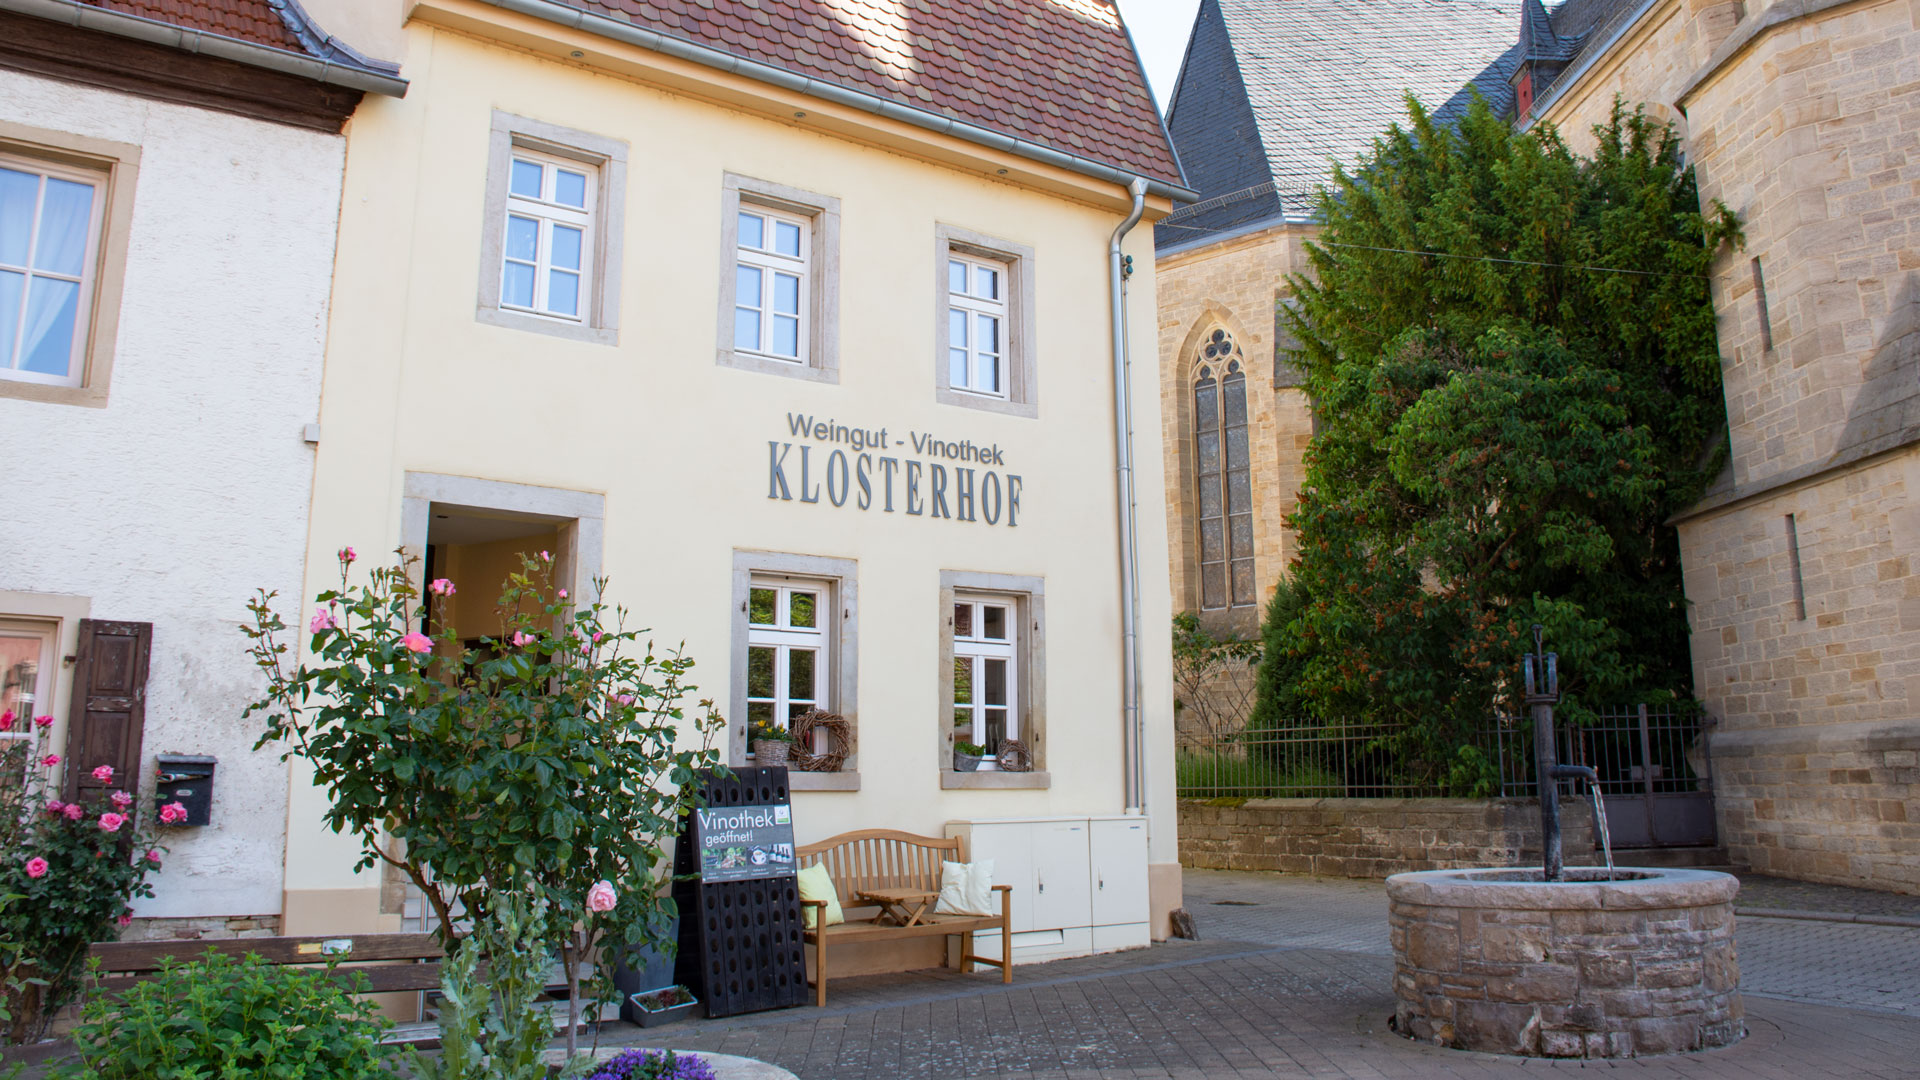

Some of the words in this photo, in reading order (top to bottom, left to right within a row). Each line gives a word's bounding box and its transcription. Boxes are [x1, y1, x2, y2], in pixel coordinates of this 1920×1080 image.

[788, 412, 887, 451] Weingut
[911, 431, 1004, 465] Vinothek
[768, 441, 1022, 527] KLOSTERHOF
[699, 809, 774, 830] Vinothek
[705, 830, 753, 847] geöffnet!
